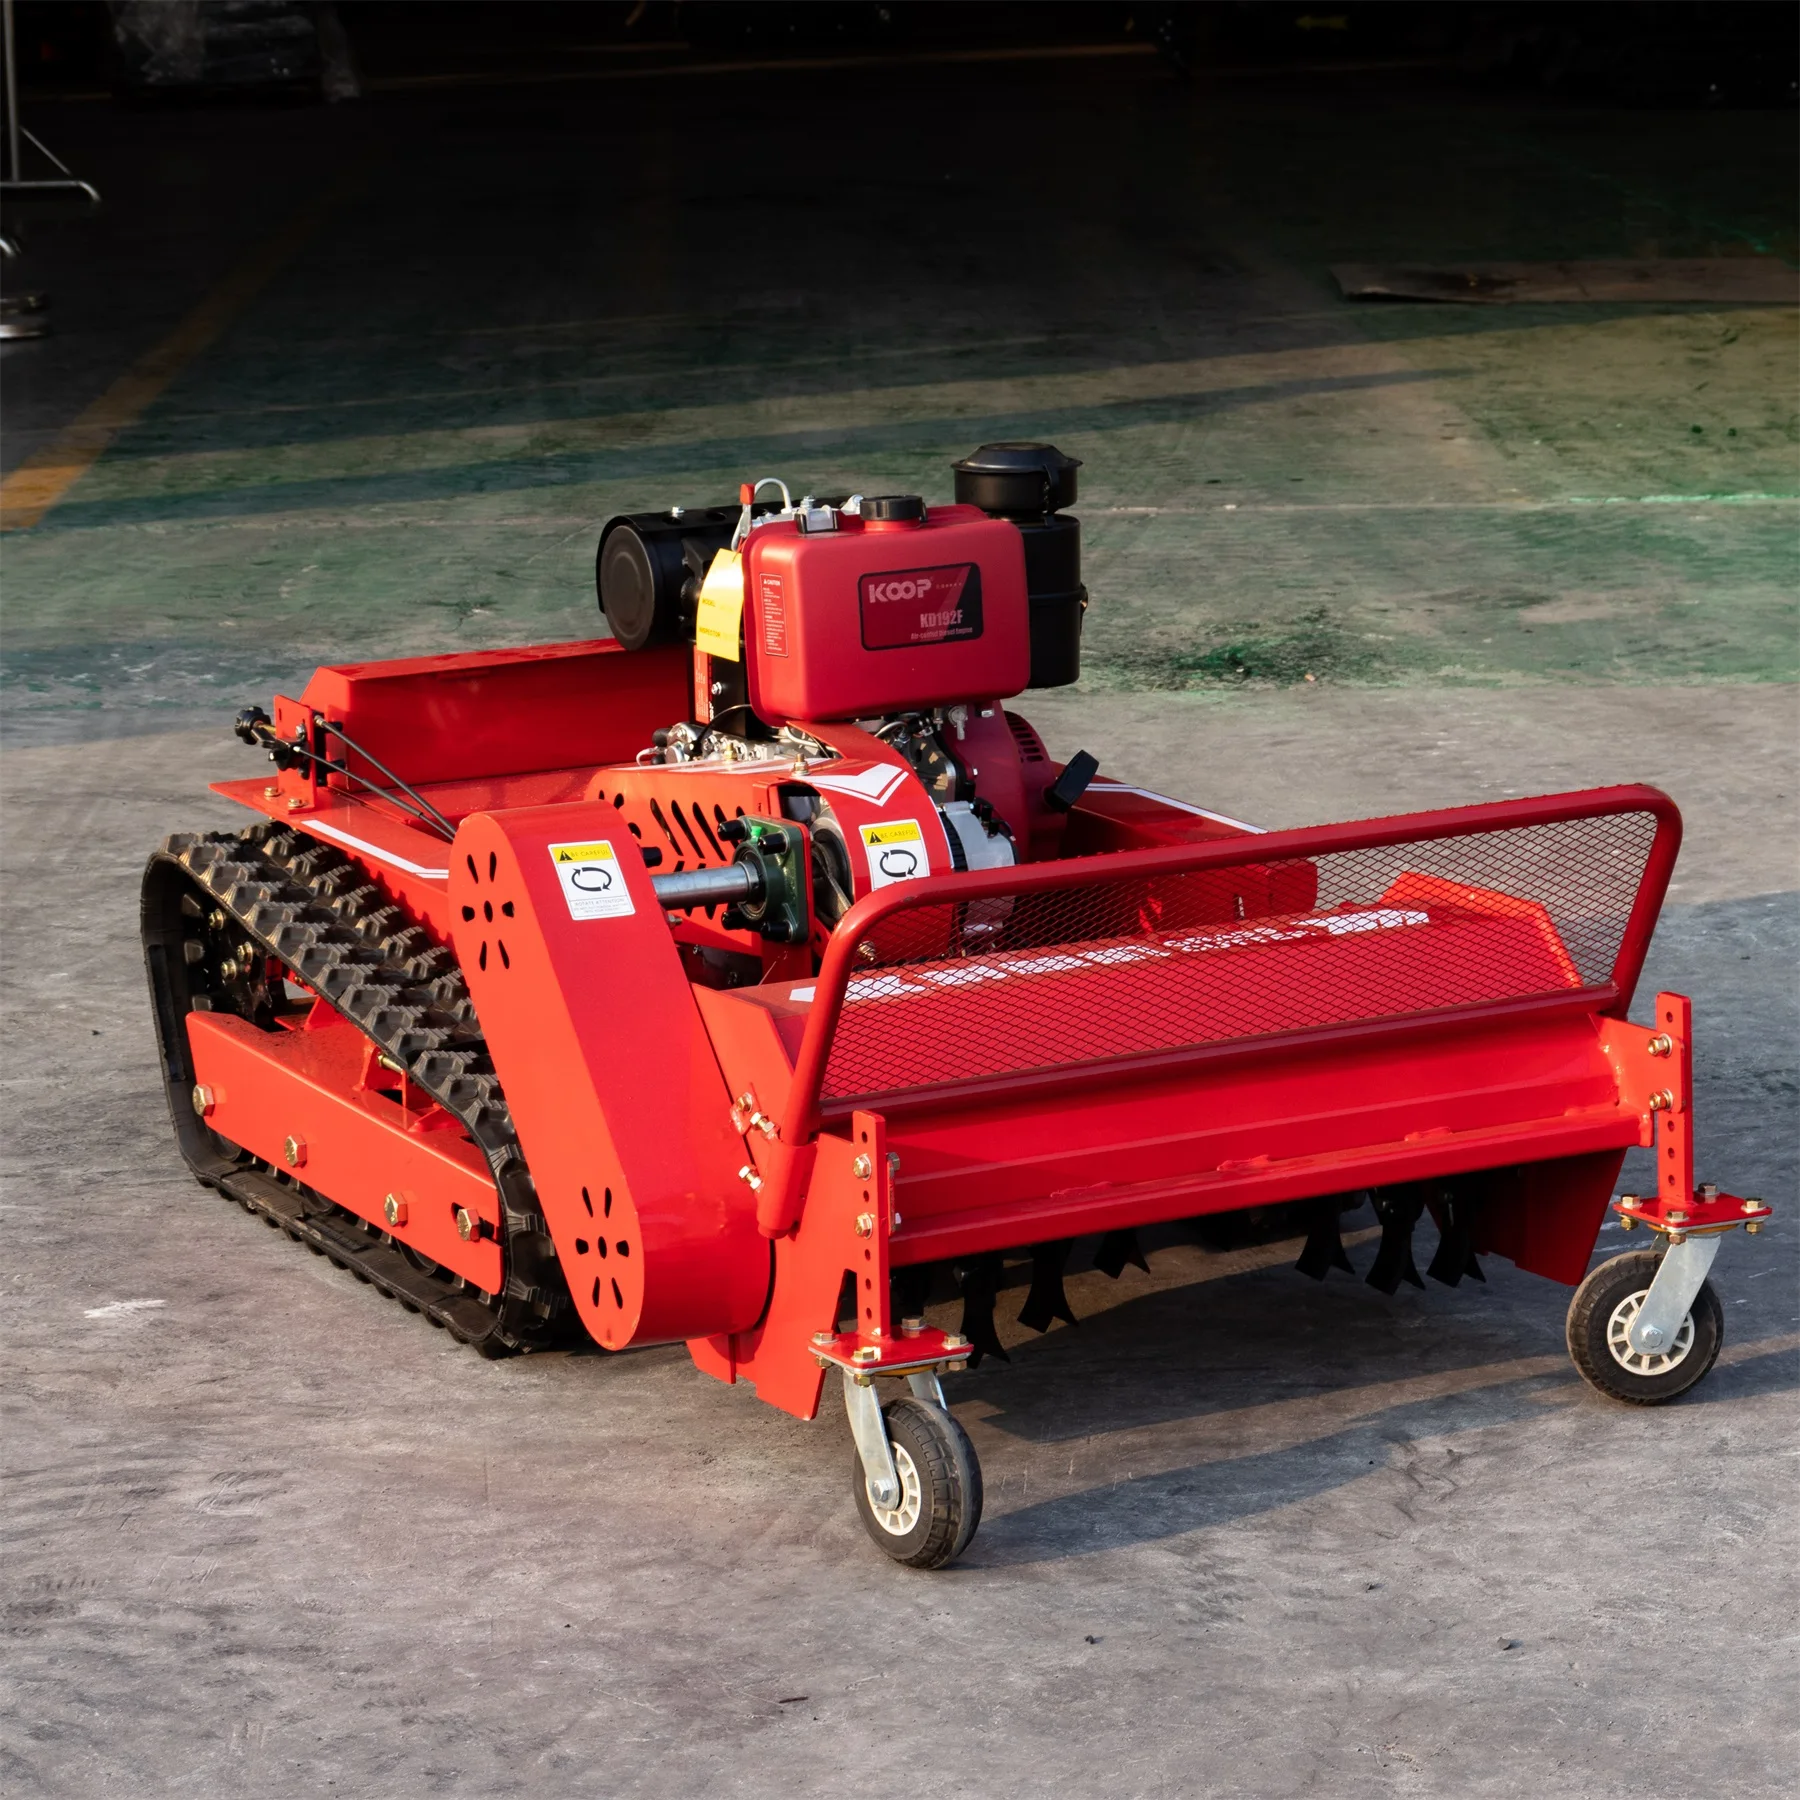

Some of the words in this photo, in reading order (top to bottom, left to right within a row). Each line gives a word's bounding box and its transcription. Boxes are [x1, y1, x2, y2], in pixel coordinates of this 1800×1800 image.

[868, 579, 932, 603] KOOP
[920, 609, 963, 628] KD192F
[699, 627, 720, 637] INSPECTOR
[890, 829, 917, 837] CAREFUL
